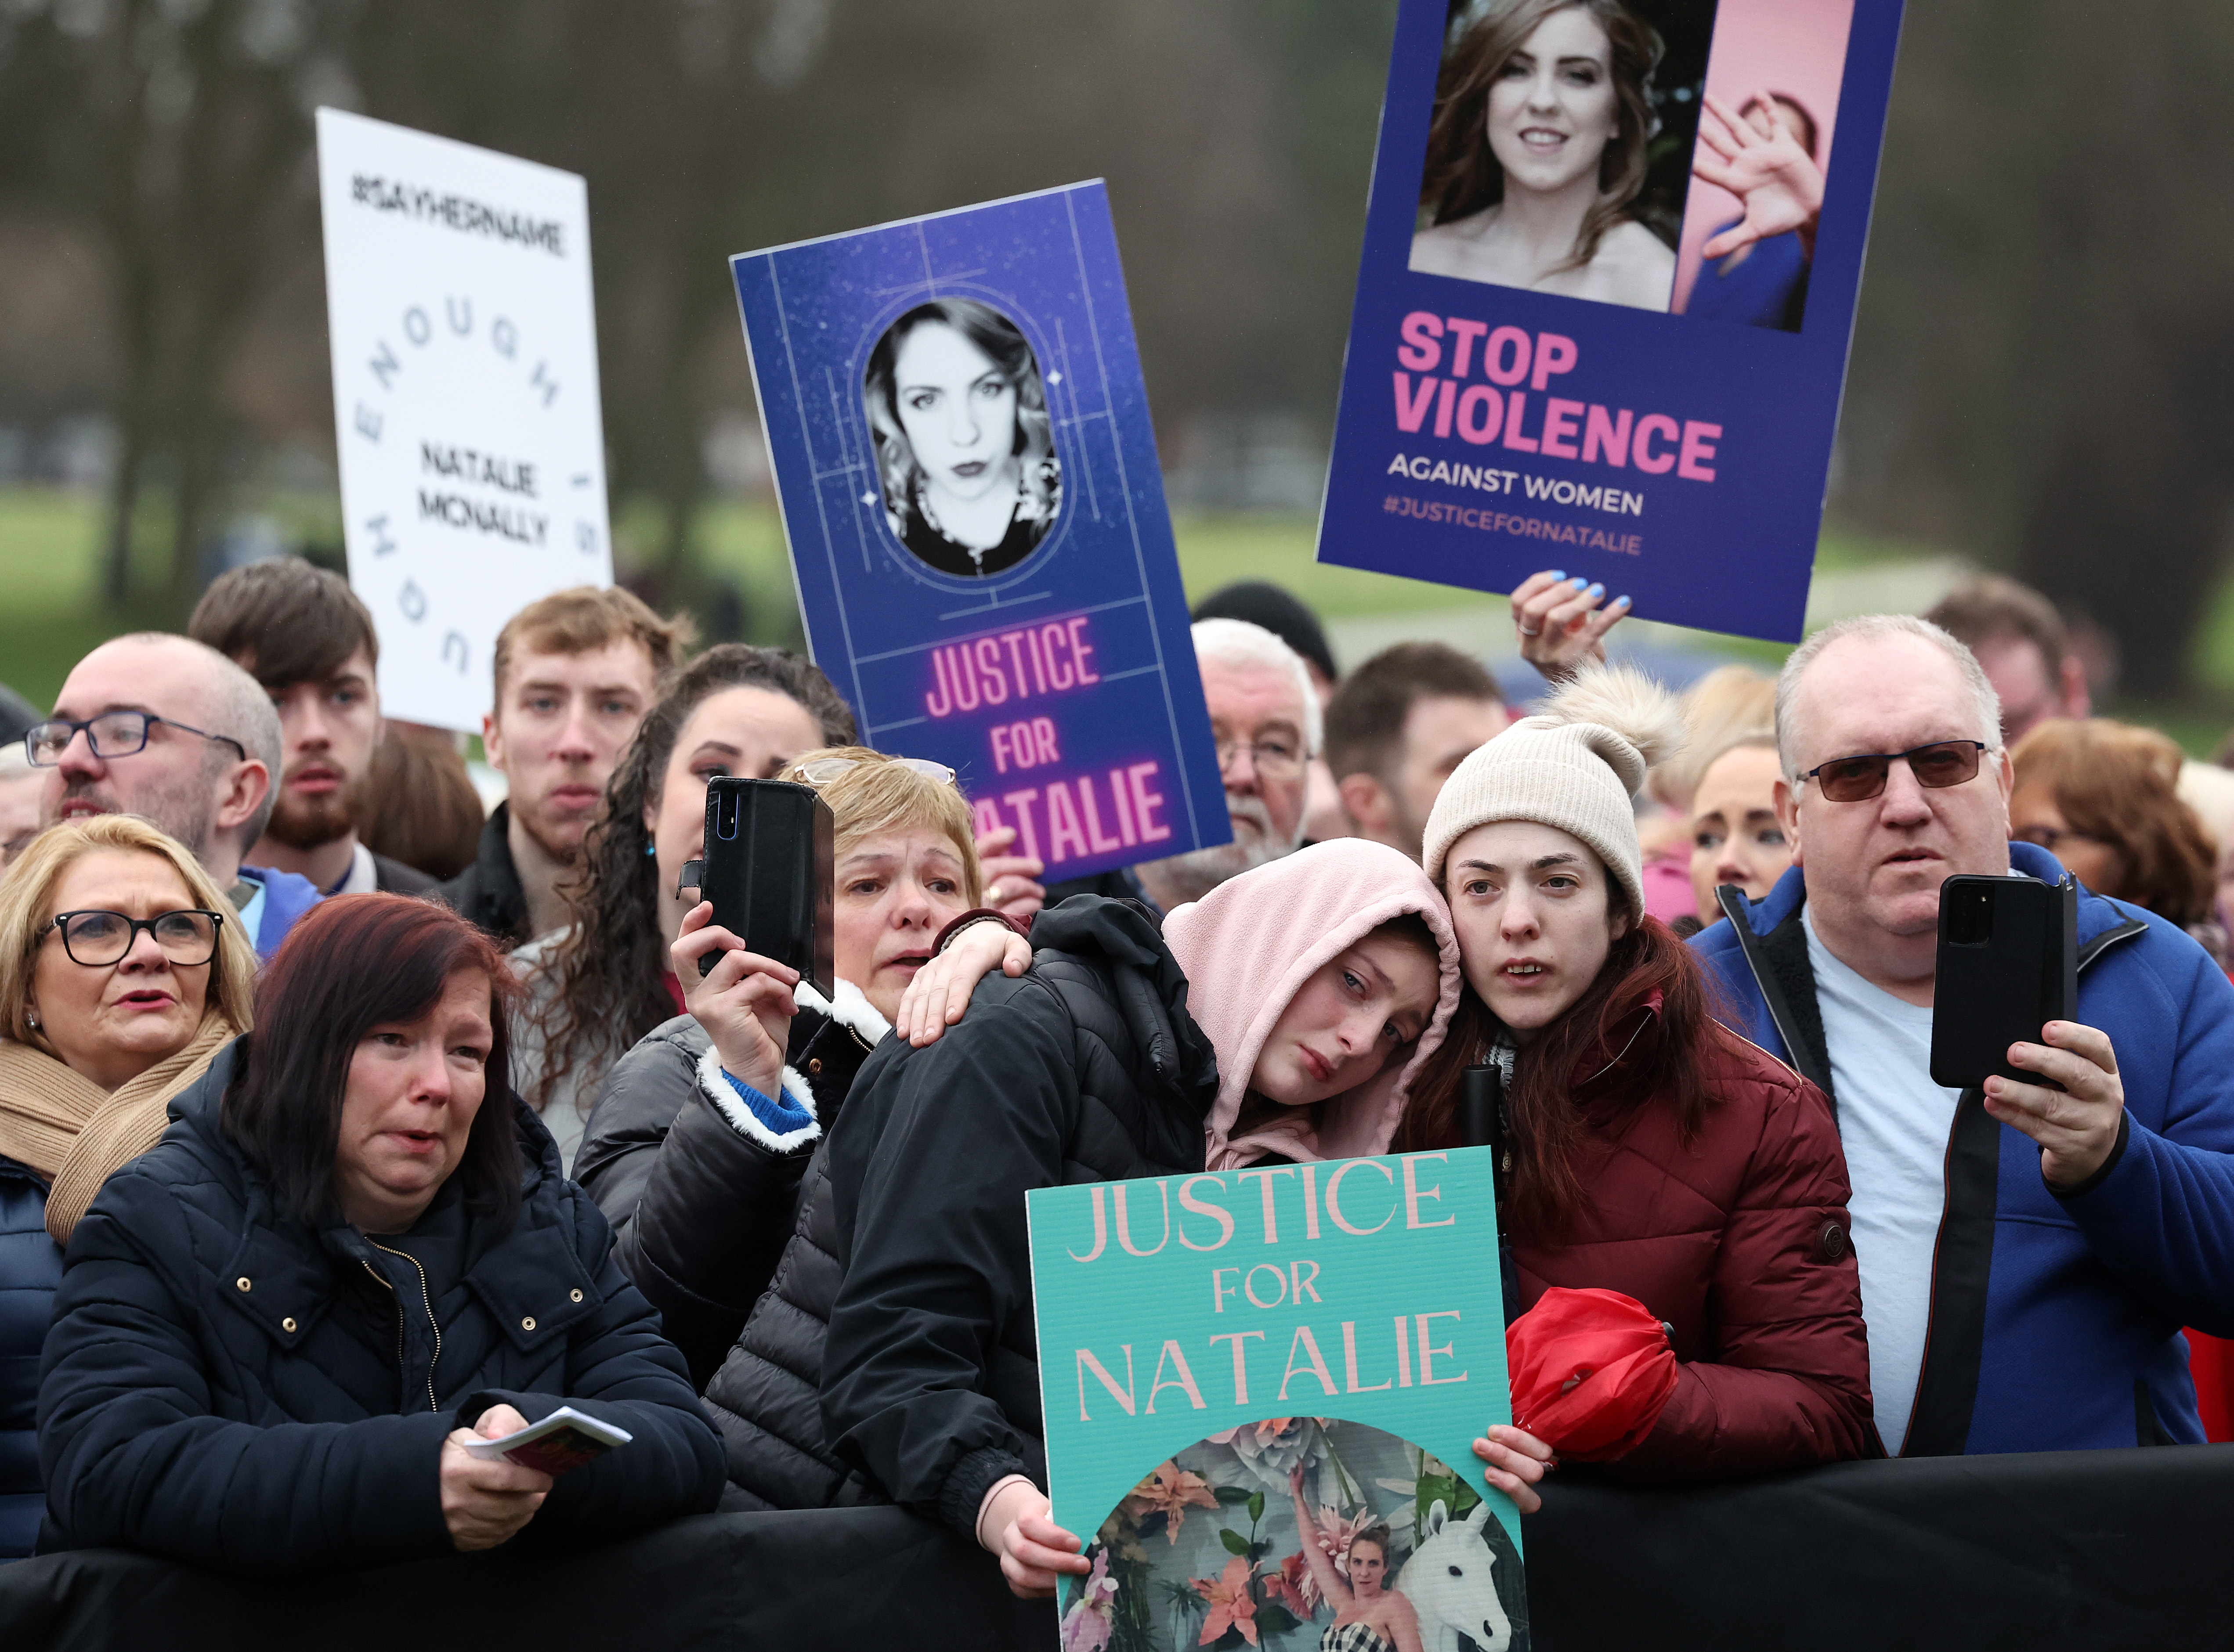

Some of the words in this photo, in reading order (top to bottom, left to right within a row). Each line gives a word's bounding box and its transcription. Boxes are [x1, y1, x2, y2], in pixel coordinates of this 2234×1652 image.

[350, 172, 568, 258] #SAYHERNAME
[1397, 310, 1579, 391] STOP
[1393, 372, 1723, 483] VIOLENCE
[420, 439, 539, 500] NATALIE
[1387, 453, 1519, 495] AGAINST
[1524, 474, 1644, 516] WOMEN
[1383, 495, 1644, 556] #JUSTICEFORNATALIE
[926, 616, 1100, 718] JUSTICE
[990, 717, 1059, 774] FOR
[974, 761, 1171, 863] ATALIE
[1066, 1152, 1455, 1263] JUSTICE
[1212, 1260, 1323, 1313] FOR
[1075, 1310, 1468, 1422] NATALIE
